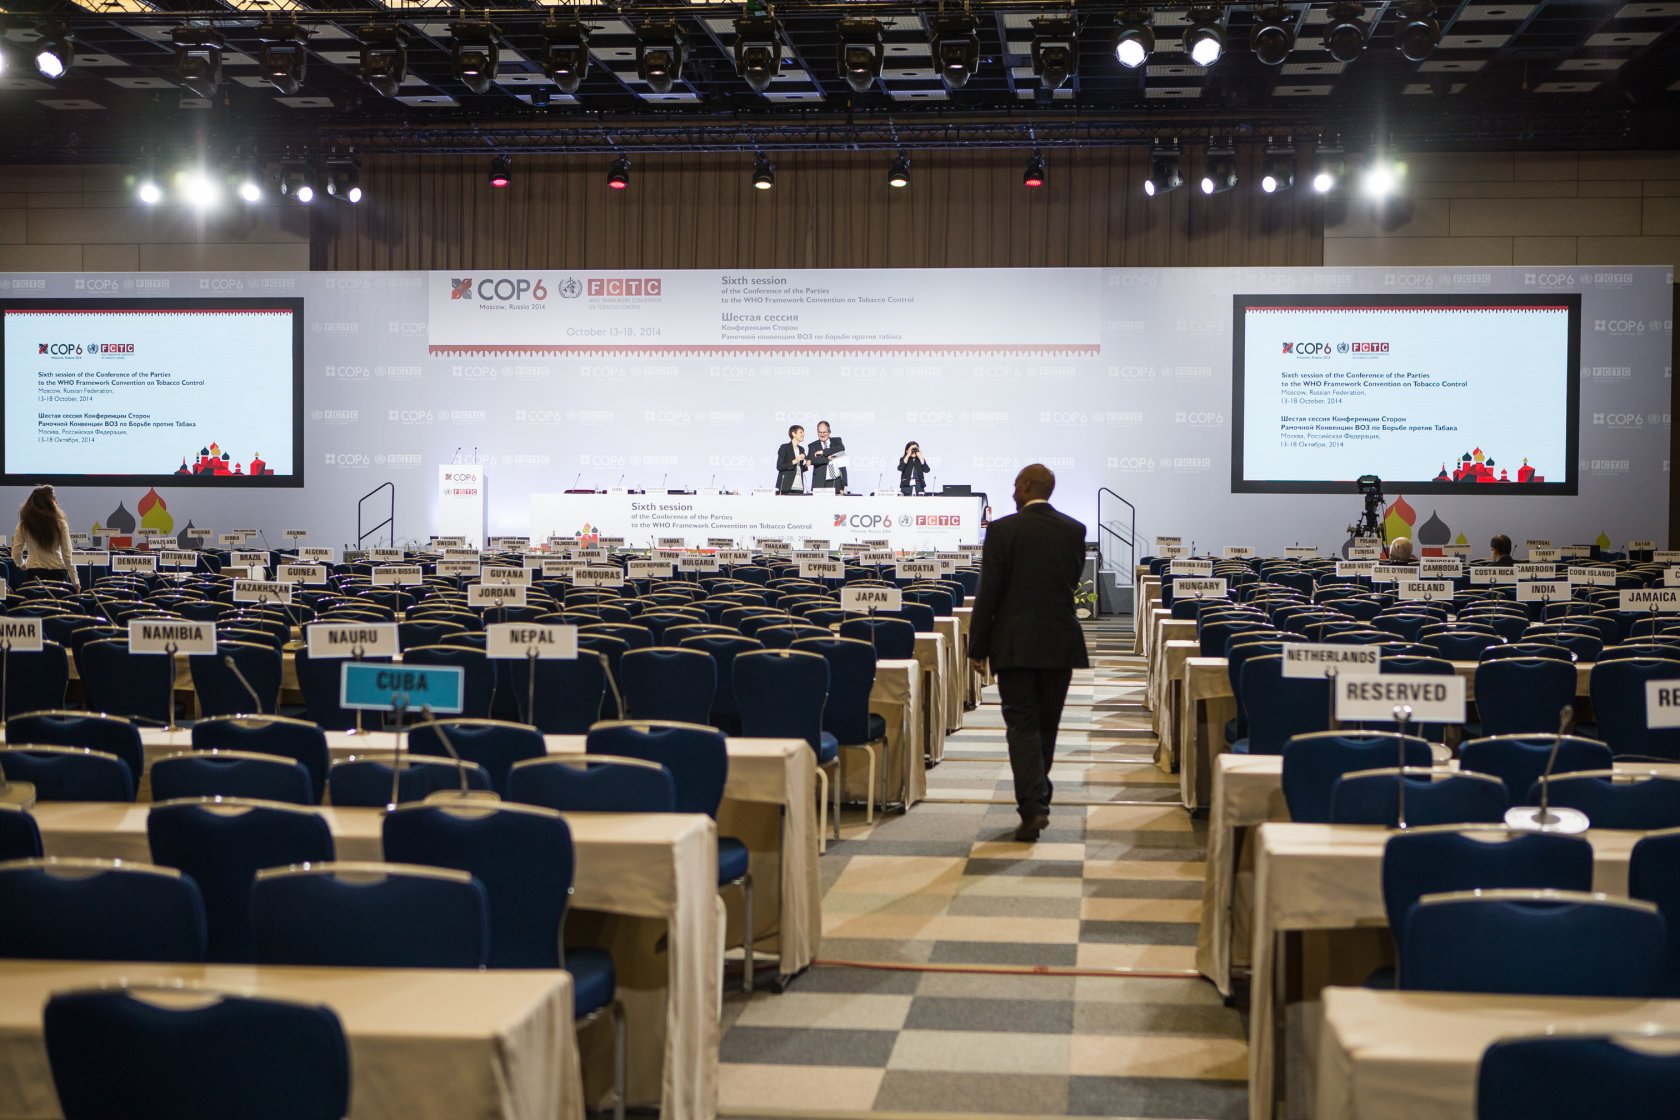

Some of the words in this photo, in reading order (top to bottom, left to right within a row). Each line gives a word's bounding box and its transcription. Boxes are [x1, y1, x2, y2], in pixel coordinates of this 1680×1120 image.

[721, 276, 748, 285] Sixth
[751, 276, 787, 285] session
[477, 279, 547, 300] COP6
[588, 279, 661, 296] FCTC
[721, 312, 761, 322] Шестая
[764, 314, 799, 322] сессия
[566, 327, 607, 337] October
[609, 327, 636, 338] 13-18,
[640, 327, 661, 337] 2014
[50, 343, 83, 355] COP6
[101, 343, 135, 353] FCTC
[1295, 342, 1332, 355] COP6
[1352, 342, 1389, 353] FCTC
[631, 502, 656, 511] Sixth
[659, 502, 693, 511] session
[849, 514, 892, 527] COP6
[916, 515, 960, 525] FCTC
[117, 557, 152, 565] DENMARK
[161, 552, 196, 561] BOTSWANA
[287, 567, 317, 576] GUINEA
[807, 564, 837, 572] CYPRUS
[903, 564, 935, 572] CROATIA
[1474, 568, 1496, 576] COSTA
[490, 569, 523, 578] GUYANA
[576, 571, 621, 580] HONDURAS
[236, 583, 289, 594] KAZAKHSTAN
[1179, 582, 1220, 590] HUNGARY
[1408, 583, 1445, 592] ICELAND
[1531, 585, 1556, 594] INDIA
[478, 588, 516, 598] JORDAN
[855, 592, 888, 602] JAPAN
[1628, 592, 1677, 602] JAMAICA
[142, 625, 203, 641] NAMIBIA
[328, 630, 378, 645] NAURU
[510, 629, 555, 644] NEPAL
[1287, 649, 1378, 665] NETHERLANDS
[376, 671, 428, 691] CUBA
[1346, 682, 1447, 702] RESERVED
